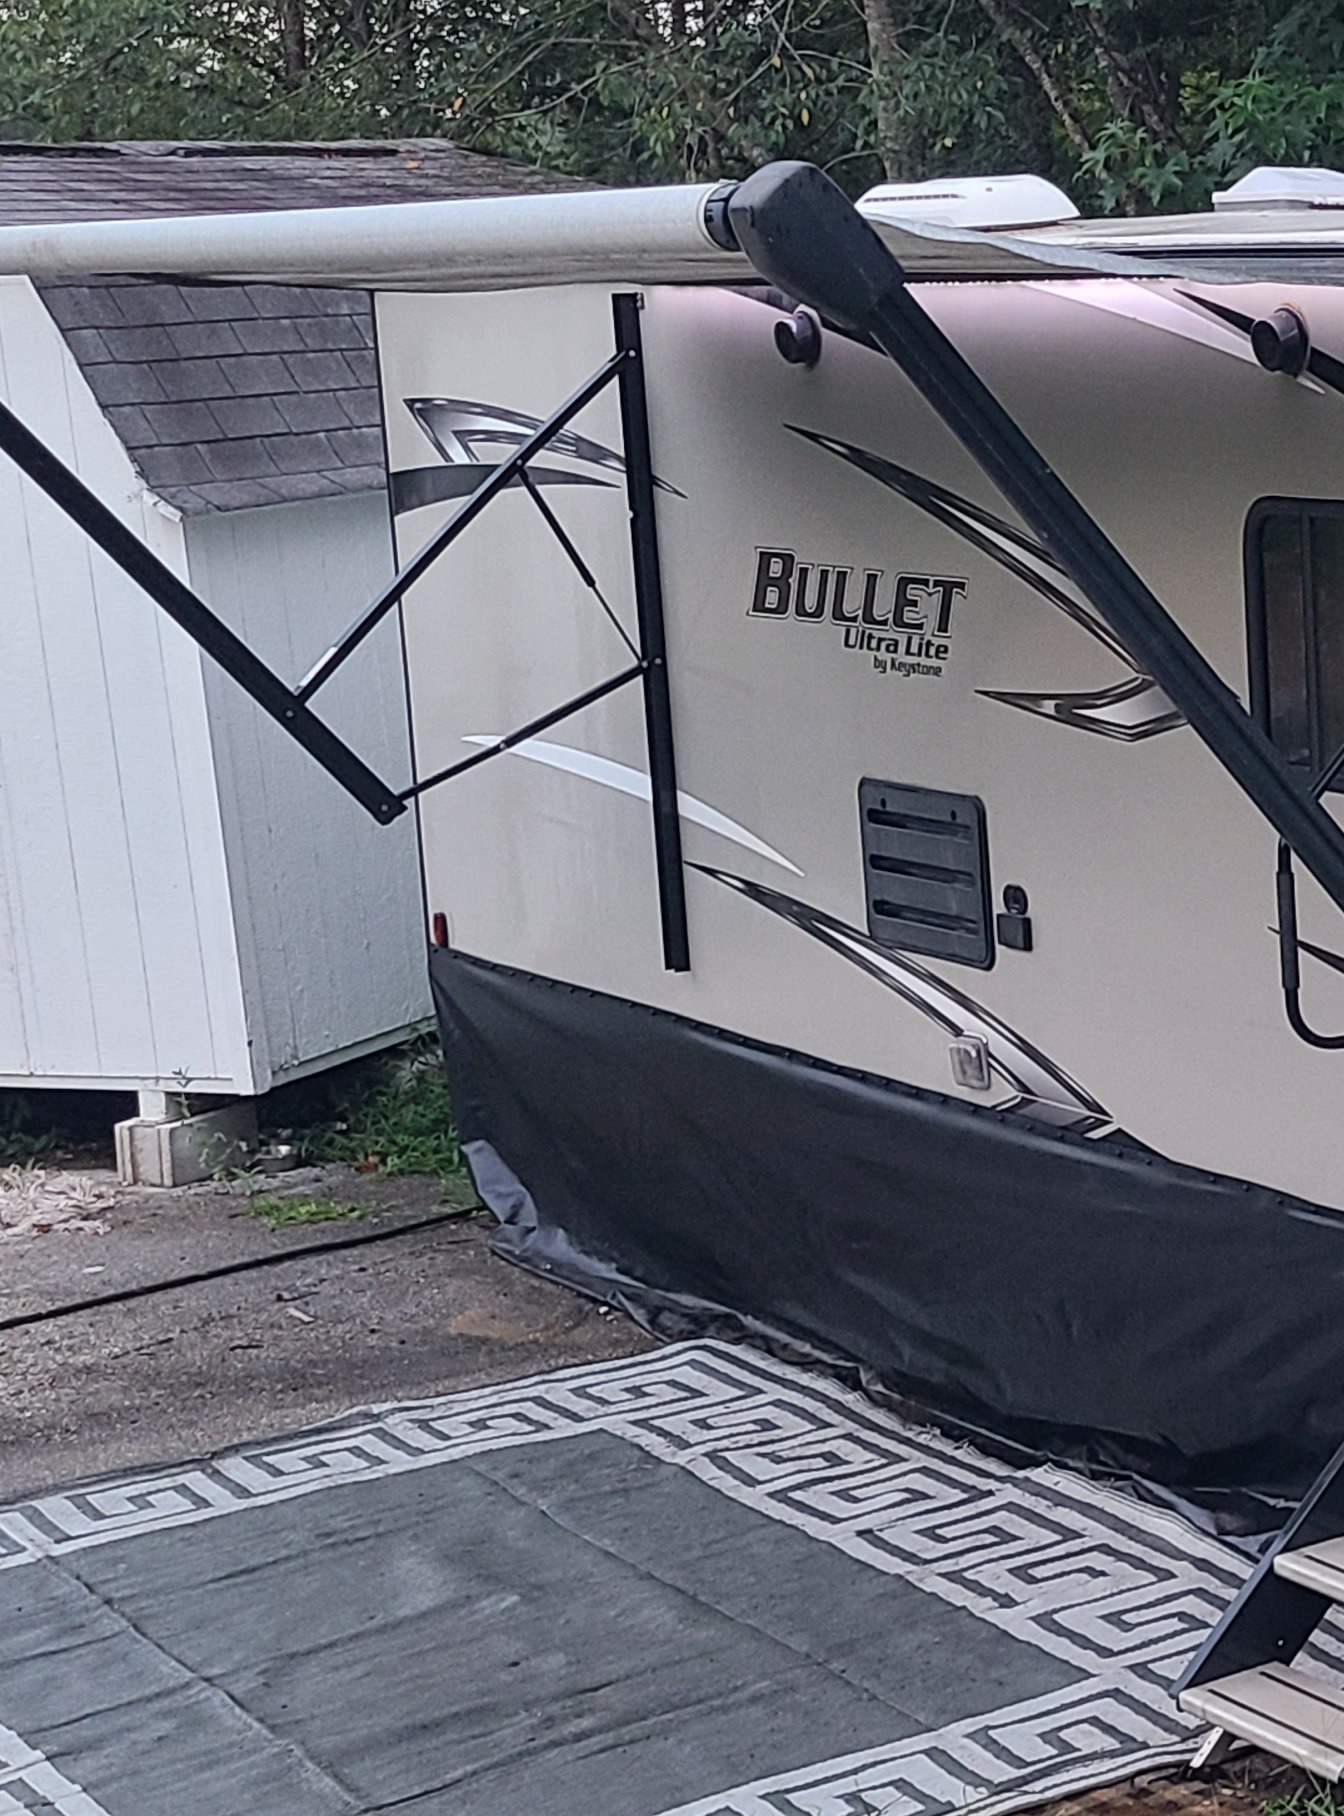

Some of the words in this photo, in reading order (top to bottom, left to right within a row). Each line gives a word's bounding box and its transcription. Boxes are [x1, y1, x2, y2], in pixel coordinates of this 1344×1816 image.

[746, 546, 969, 638] BULLET
[843, 627, 899, 655] Ultra
[904, 635, 949, 660] Lite
[873, 655, 888, 673] by
[890, 657, 943, 677] Keystone
